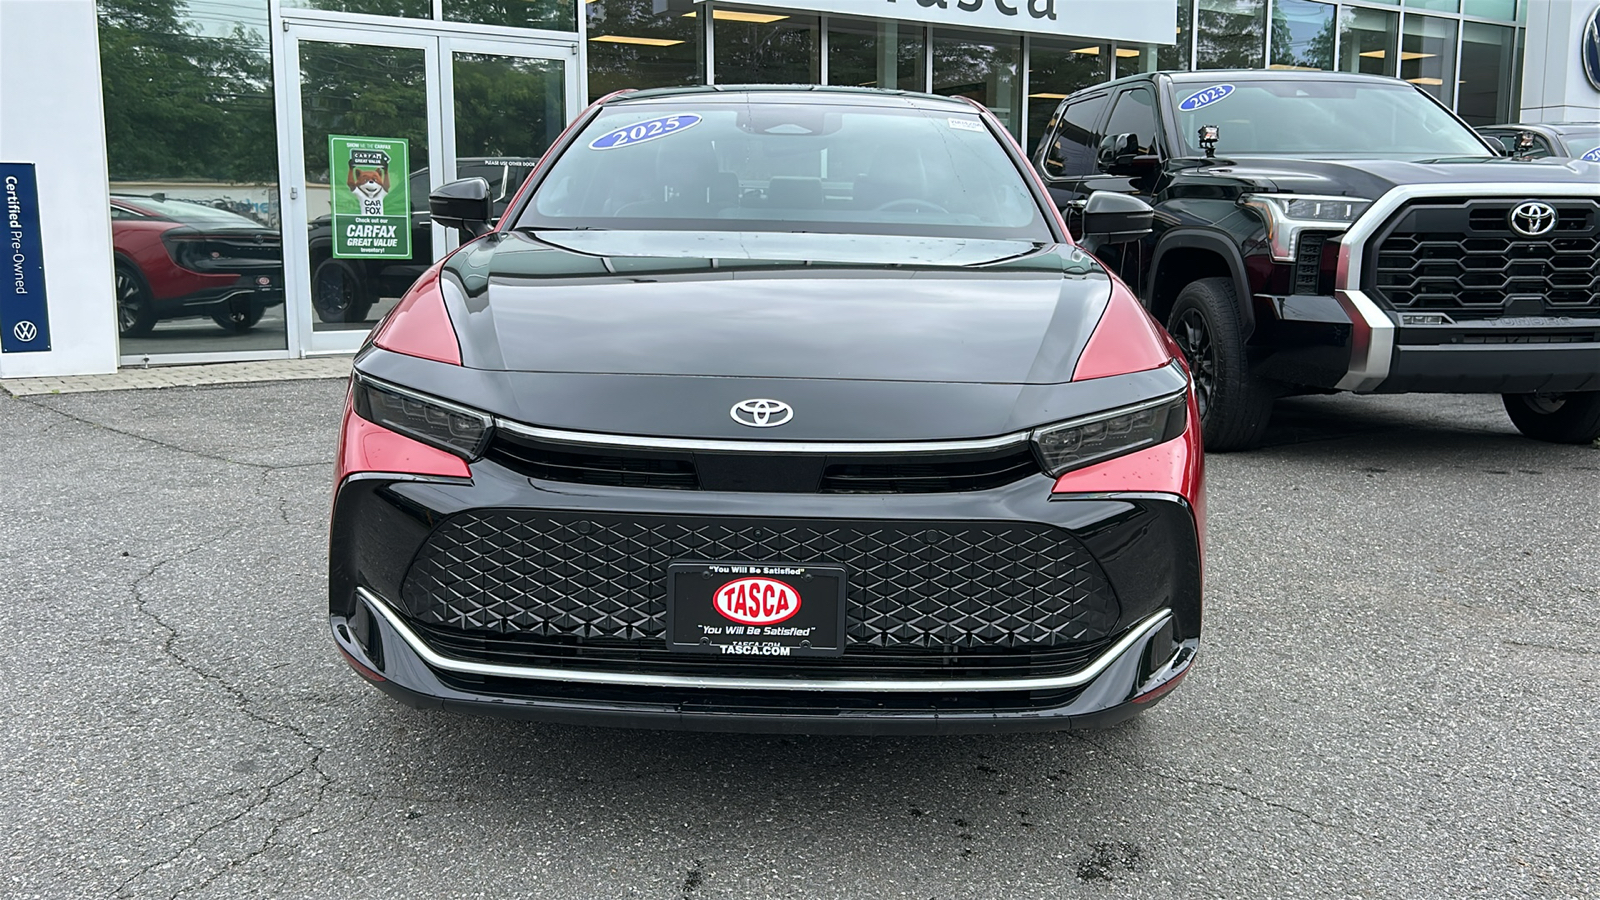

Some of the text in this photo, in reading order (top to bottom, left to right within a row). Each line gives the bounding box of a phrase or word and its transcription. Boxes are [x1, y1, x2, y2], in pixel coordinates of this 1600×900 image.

[1190, 86, 1226, 107] 2023
[612, 116, 680, 146] 2025
[365, 207, 381, 215] FOX
[5, 175, 28, 294] Certified Pre-Owned
[346, 224, 397, 238] CARFAX
[346, 238, 398, 247] GREAT VALUE
[749, 566, 761, 574] Be
[723, 582, 790, 618] TASCA
[725, 625, 745, 635] Will
[746, 626, 761, 635] Be
[720, 645, 791, 656] TASCA.COM
